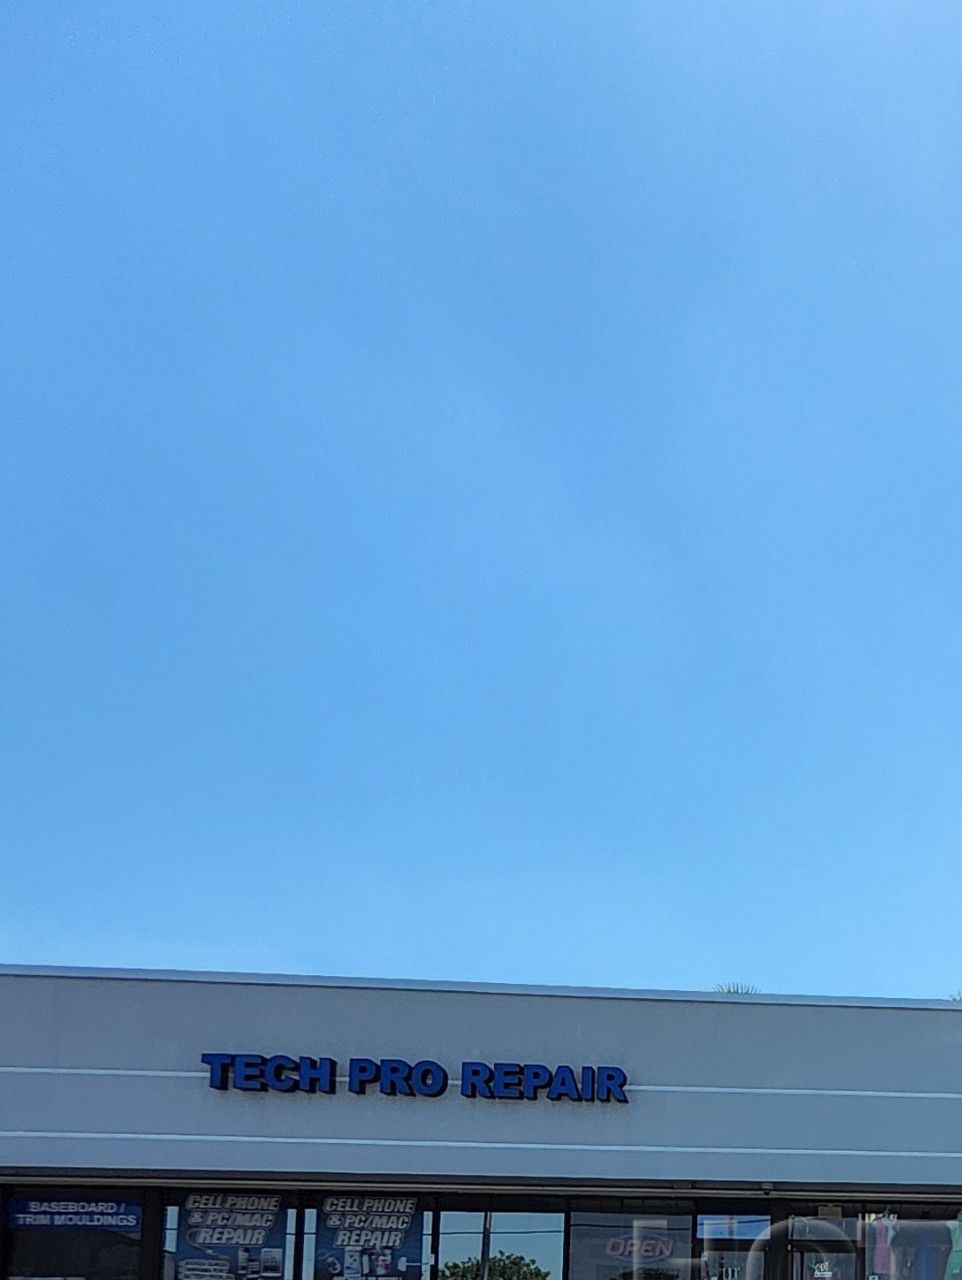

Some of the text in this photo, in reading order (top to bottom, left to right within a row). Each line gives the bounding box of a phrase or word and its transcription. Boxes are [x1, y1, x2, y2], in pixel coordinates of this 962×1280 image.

[201, 1053, 629, 1103] TECH PRO REPAIR
[29, 1202, 118, 1213] BASEBOARD
[187, 1195, 280, 1211] CELL PHONE
[325, 1198, 416, 1213] CELL PHONE
[16, 1214, 137, 1226] TRIM MOULDINGS
[190, 1212, 274, 1228] & PC/MAC
[328, 1214, 410, 1230] & PC/MAC
[197, 1228, 267, 1245] REPAIR
[335, 1231, 403, 1247] REPAIR
[606, 1237, 674, 1257] OPEN
